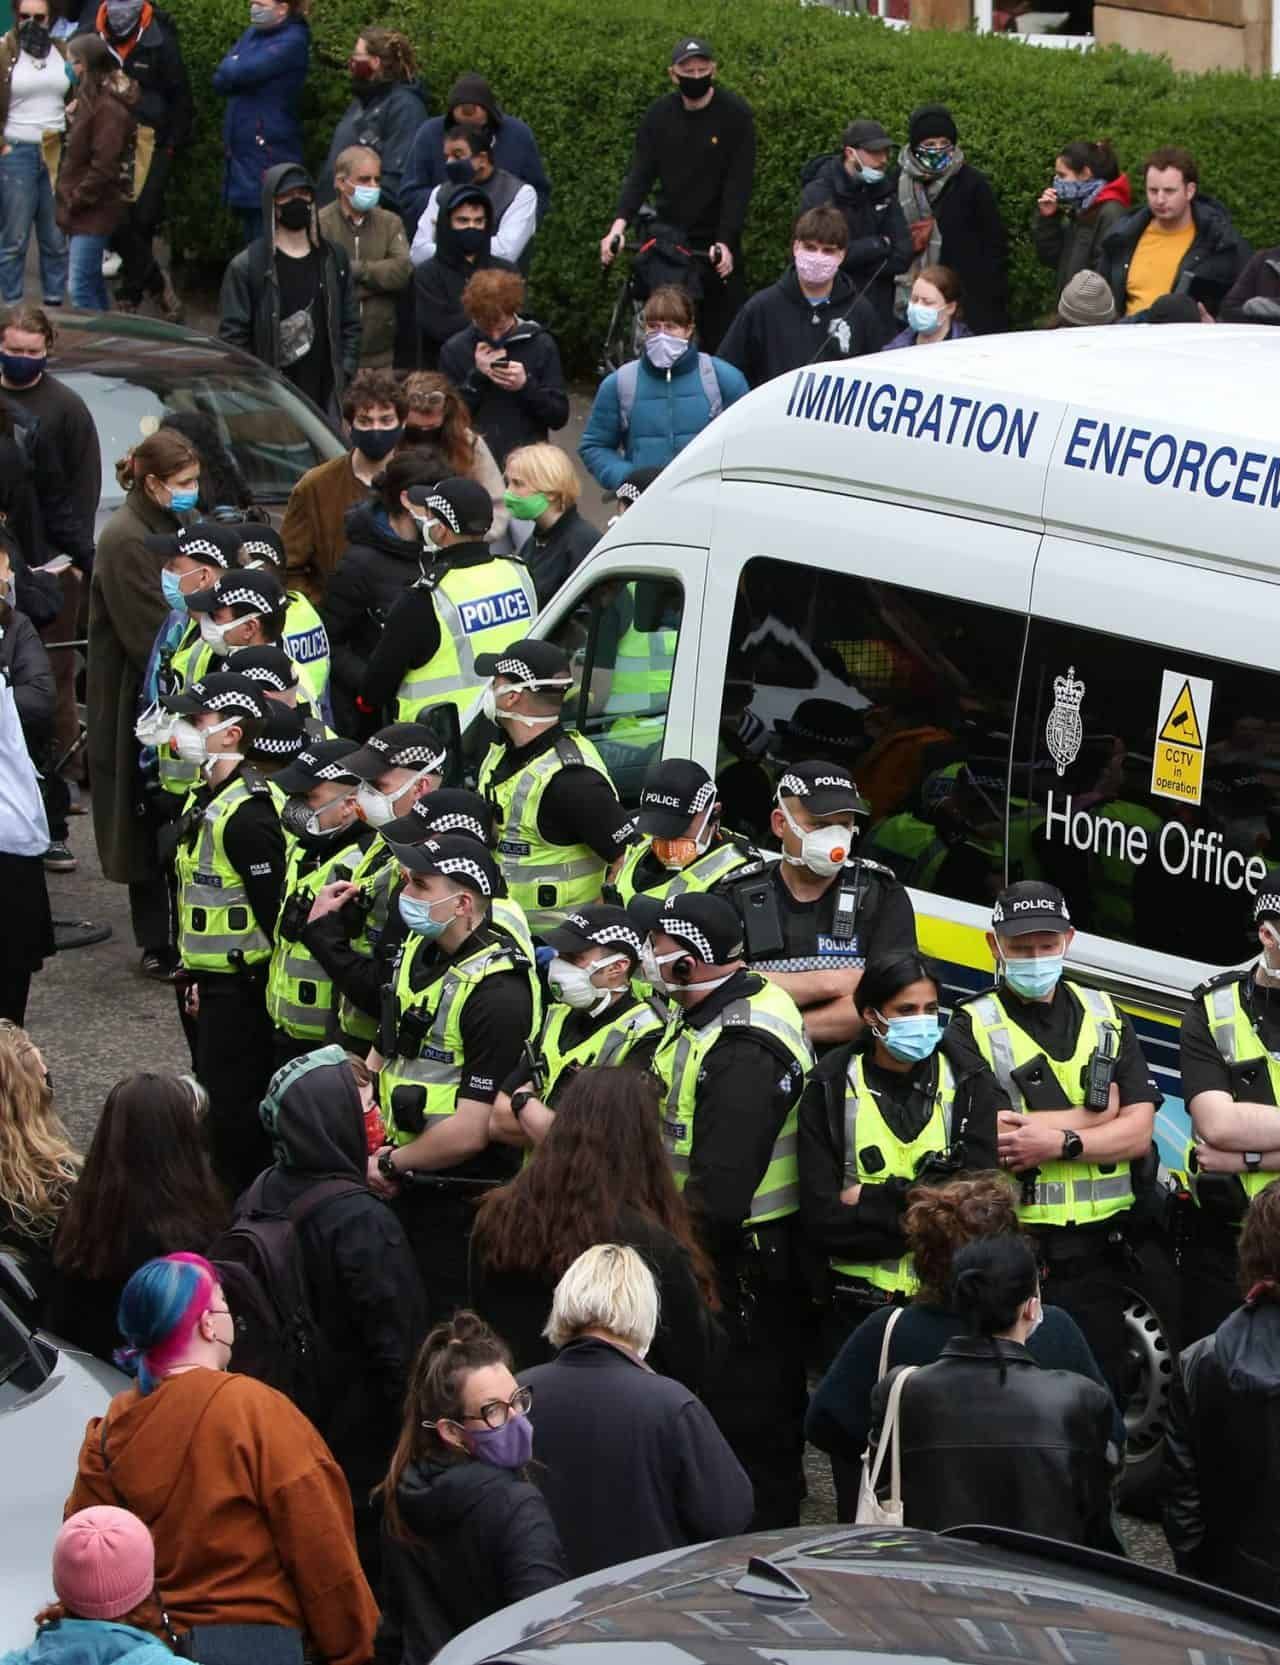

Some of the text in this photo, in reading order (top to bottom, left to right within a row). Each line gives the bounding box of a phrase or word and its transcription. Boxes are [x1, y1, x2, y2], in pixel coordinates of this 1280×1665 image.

[787, 371, 1038, 458] IMMIGRATION
[463, 590, 531, 631] POLICE
[290, 628, 328, 659] POLICE
[1165, 748, 1194, 767] CCTV
[1174, 765, 1183, 778] in
[815, 776, 853, 789] POLICE
[1156, 778, 1198, 796] operation
[646, 792, 680, 808] POLICE
[1046, 790, 1268, 896] Home Office
[1013, 899, 1055, 912] POLICE
[818, 937, 858, 952] POLICE
[471, 1076, 493, 1085] POLICE
